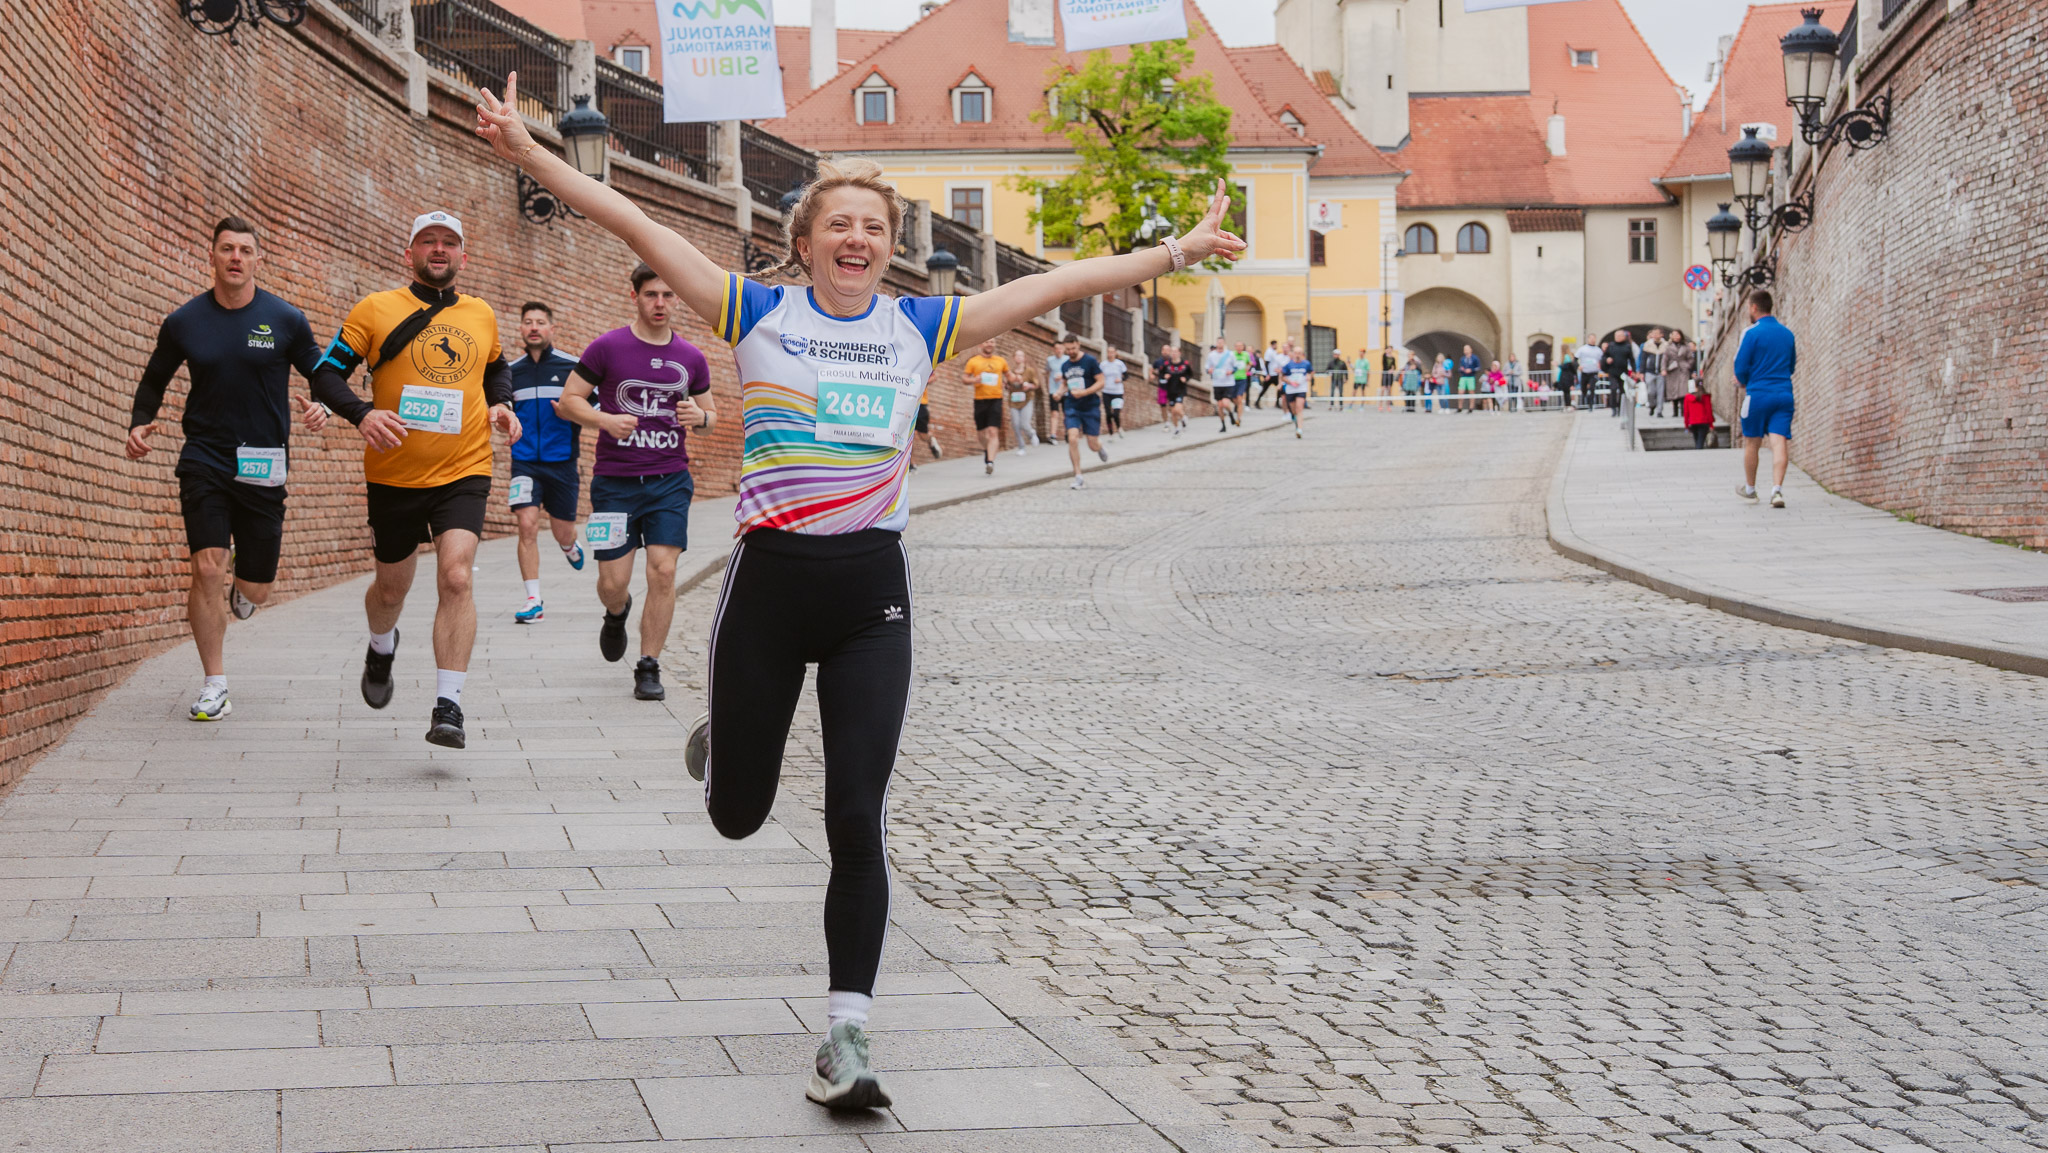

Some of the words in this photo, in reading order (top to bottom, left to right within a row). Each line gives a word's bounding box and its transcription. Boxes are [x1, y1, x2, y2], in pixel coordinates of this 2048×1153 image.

[248, 340, 275, 350] STREAM
[417, 326, 474, 347] CONTINENTAL
[809, 339, 888, 355] KROMBERG
[808, 347, 817, 357] &
[819, 348, 890, 366] SCHUBERT
[420, 366, 447, 383] SINCE
[449, 368, 468, 382] 1871
[820, 370, 858, 379] CROSUL
[403, 401, 439, 418] 2528
[825, 391, 886, 420] 2684
[242, 462, 269, 475] 2578
